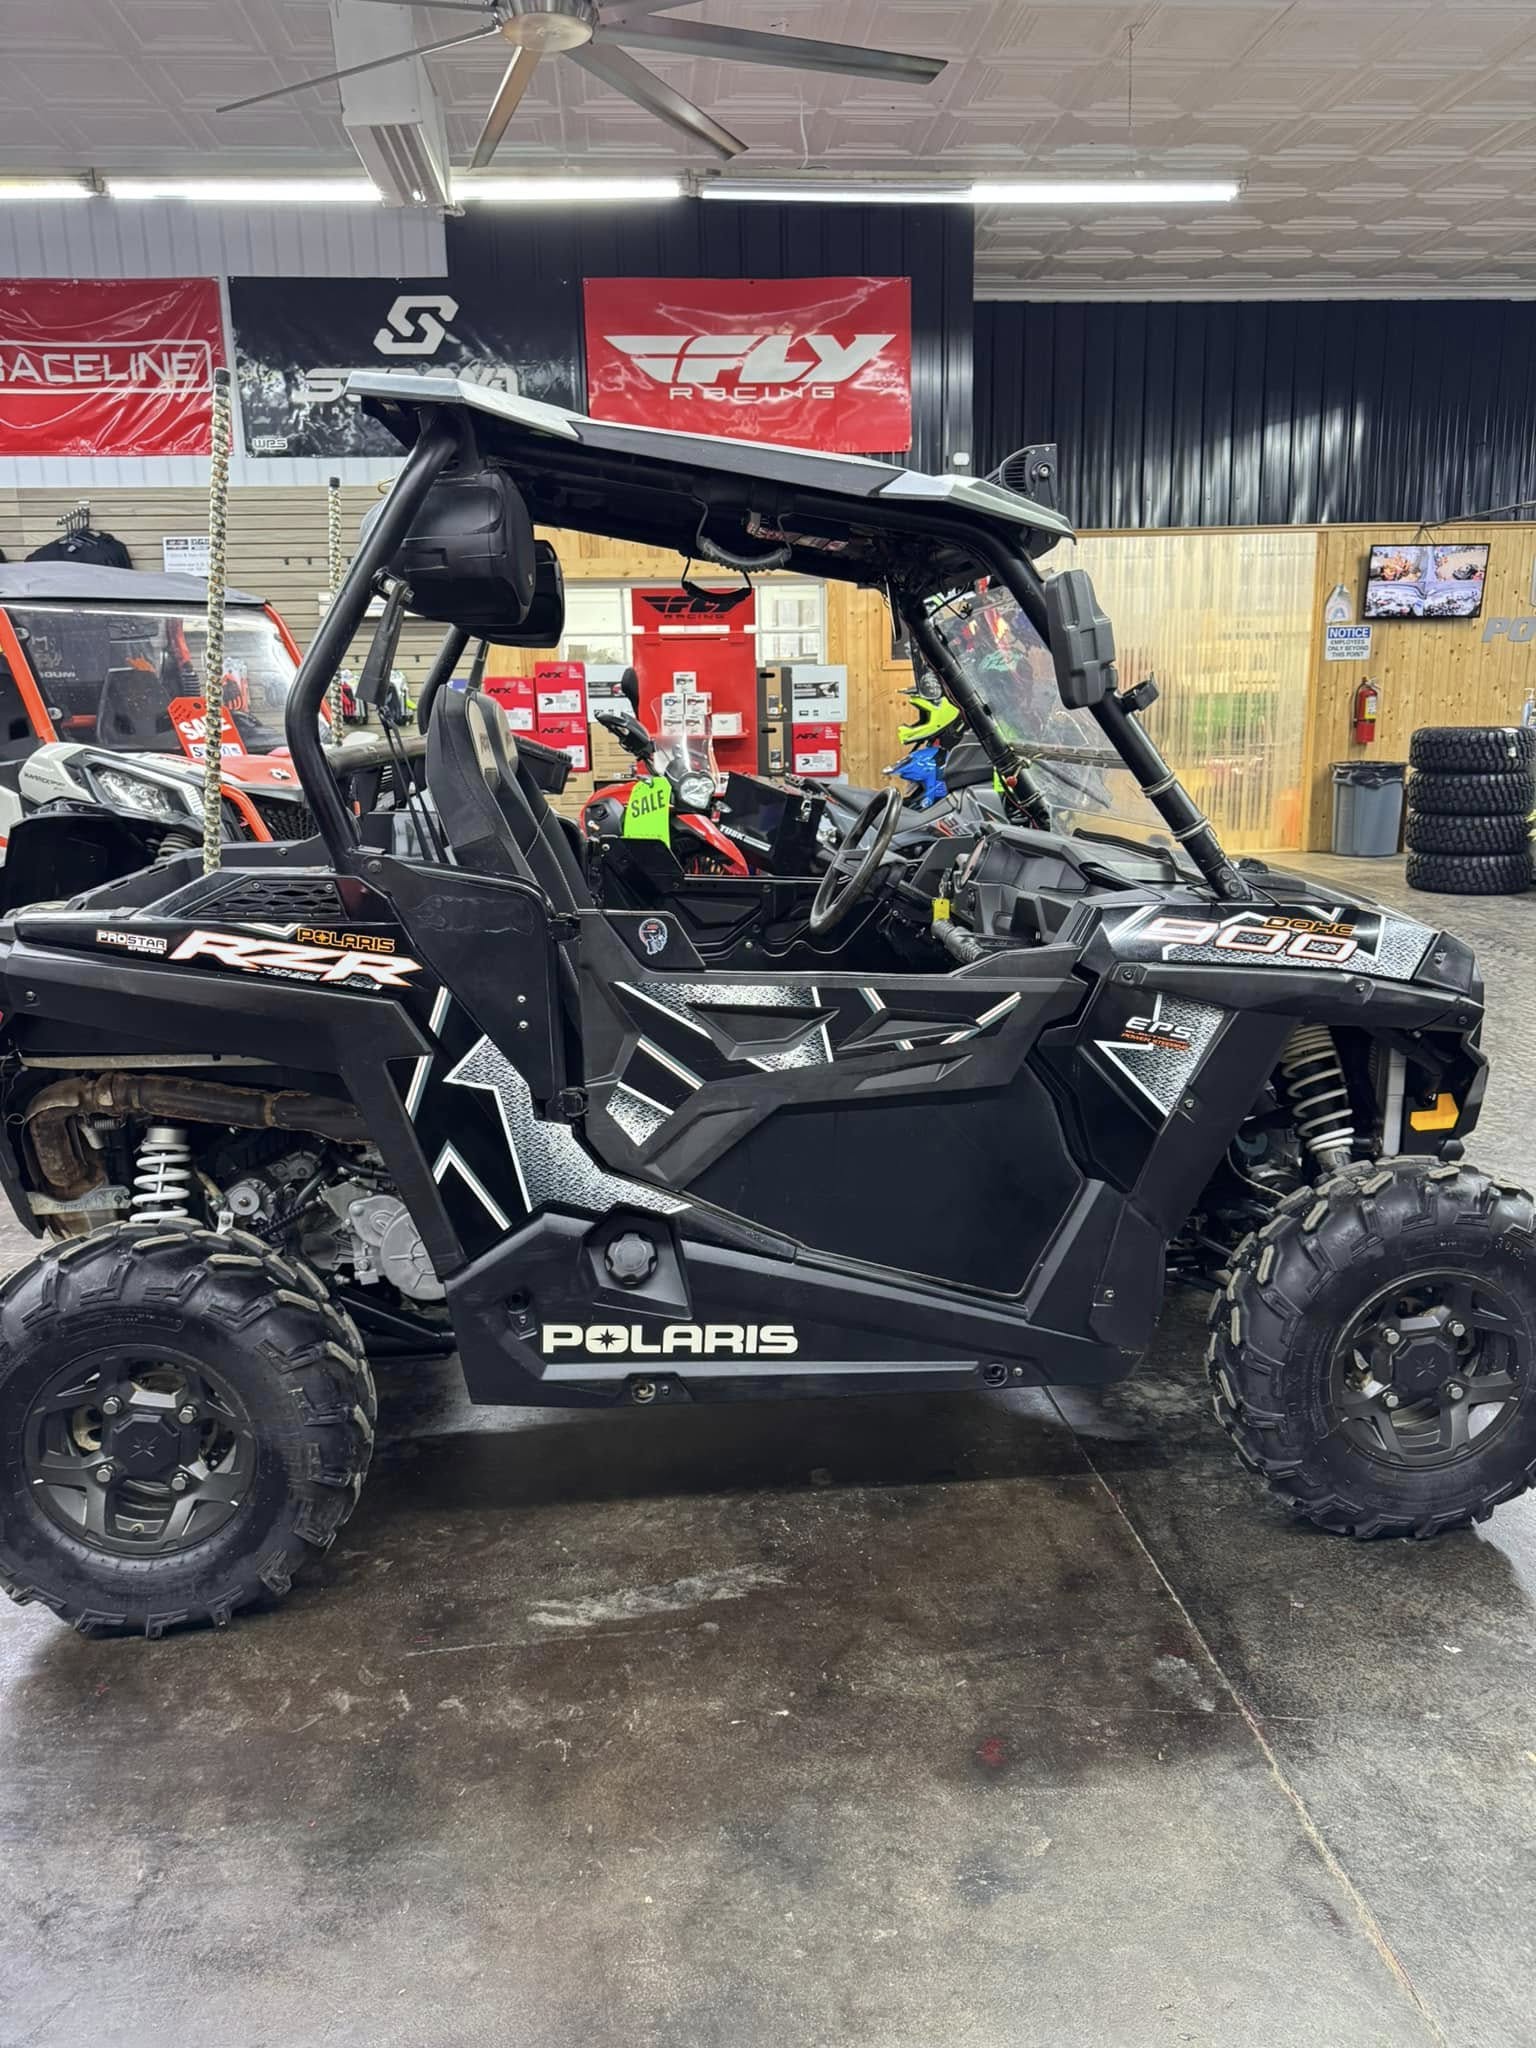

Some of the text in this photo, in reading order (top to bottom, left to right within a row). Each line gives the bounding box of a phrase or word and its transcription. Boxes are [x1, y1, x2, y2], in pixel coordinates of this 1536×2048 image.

[0, 352, 200, 383] ACELINE
[603, 334, 897, 383] FLY
[669, 386, 835, 401] RACING
[252, 437, 288, 450] WPS
[1329, 627, 1369, 638] NOTICE
[631, 790, 666, 818] SALE
[1263, 916, 1358, 936] DOHC
[297, 927, 396, 952] POLARIS
[1136, 916, 1358, 963] 900
[168, 930, 423, 986] RZR
[1125, 1016, 1196, 1039] EPS
[543, 1324, 799, 1354] POLARIS
